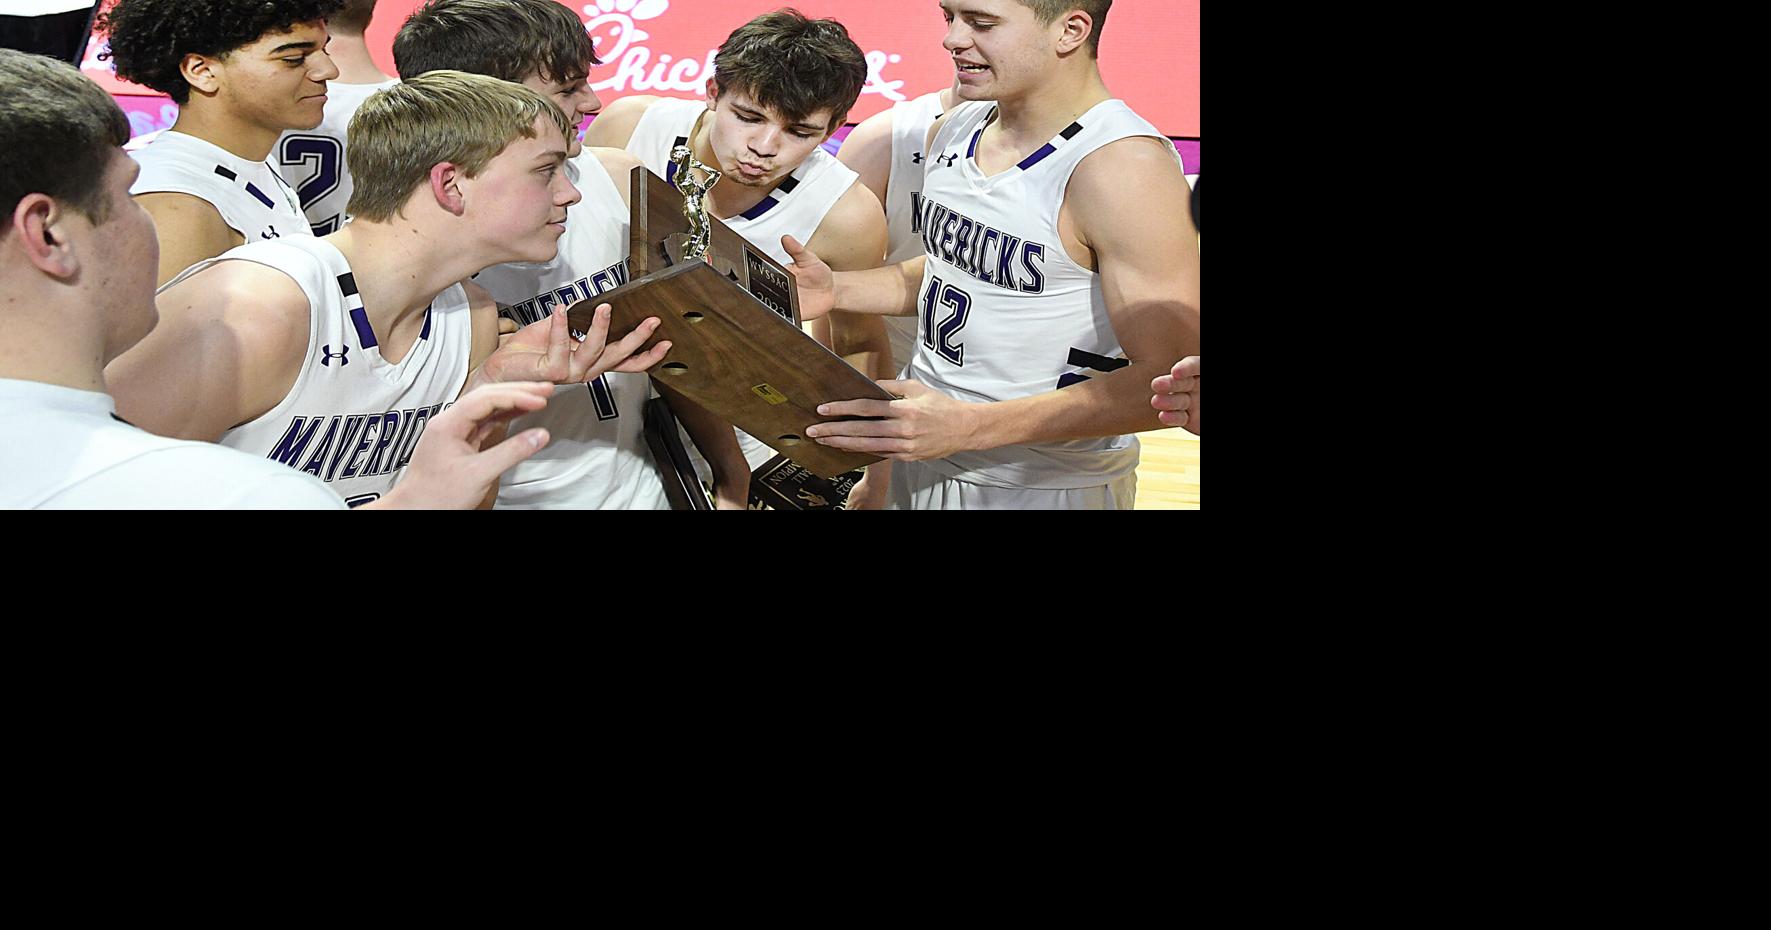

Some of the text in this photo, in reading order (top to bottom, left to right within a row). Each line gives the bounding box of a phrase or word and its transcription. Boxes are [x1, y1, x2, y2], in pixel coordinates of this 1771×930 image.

[749, 257, 788, 293] WVSSAC
[923, 275, 972, 367] 12
[266, 401, 455, 483] MAVERIC
